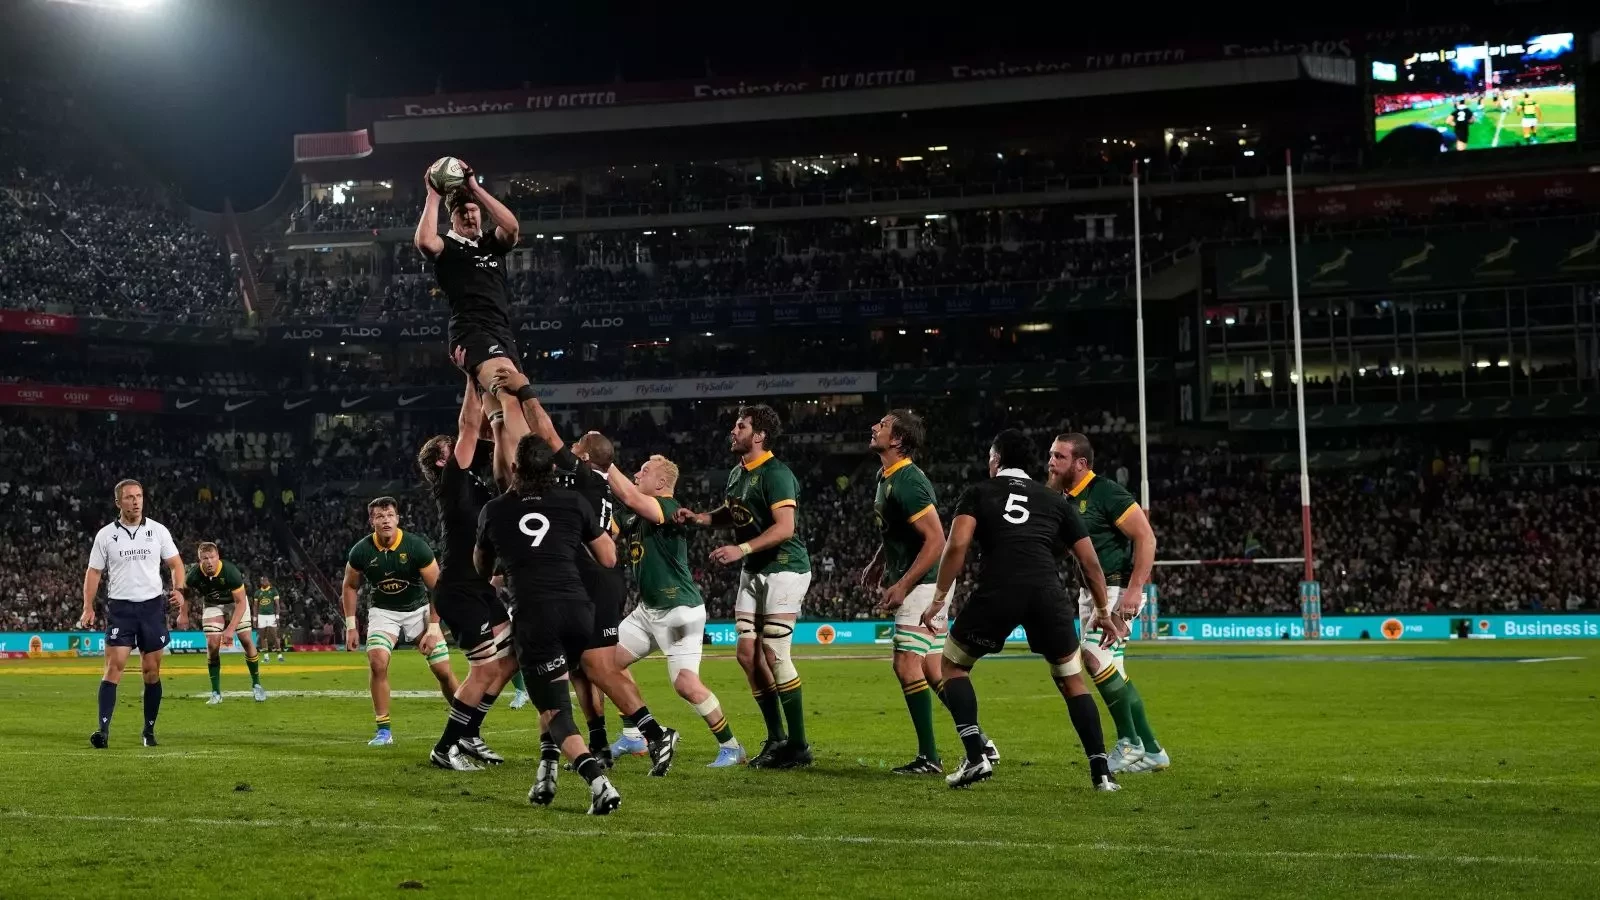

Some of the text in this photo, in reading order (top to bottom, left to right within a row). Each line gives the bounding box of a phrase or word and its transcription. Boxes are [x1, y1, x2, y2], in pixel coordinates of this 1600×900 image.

[24, 318, 56, 327] CASTLE
[519, 320, 562, 331] ALDO
[580, 317, 625, 328] ALDO
[282, 329, 324, 339] ALDO
[340, 327, 382, 336] ALDO
[400, 325, 442, 337] ALDO
[17, 390, 45, 399] CASTLE
[63, 392, 90, 401] CASTLE
[108, 394, 134, 403] CASTLE
[1002, 492, 1030, 524] 5
[518, 512, 551, 547] 9
[119, 548, 152, 558] Emirates
[603, 627, 619, 637] INE
[1201, 623, 1343, 637] Business is bter
[1505, 621, 1598, 636] Business is
[168, 638, 193, 649] tter
[536, 654, 566, 676] INEOS
